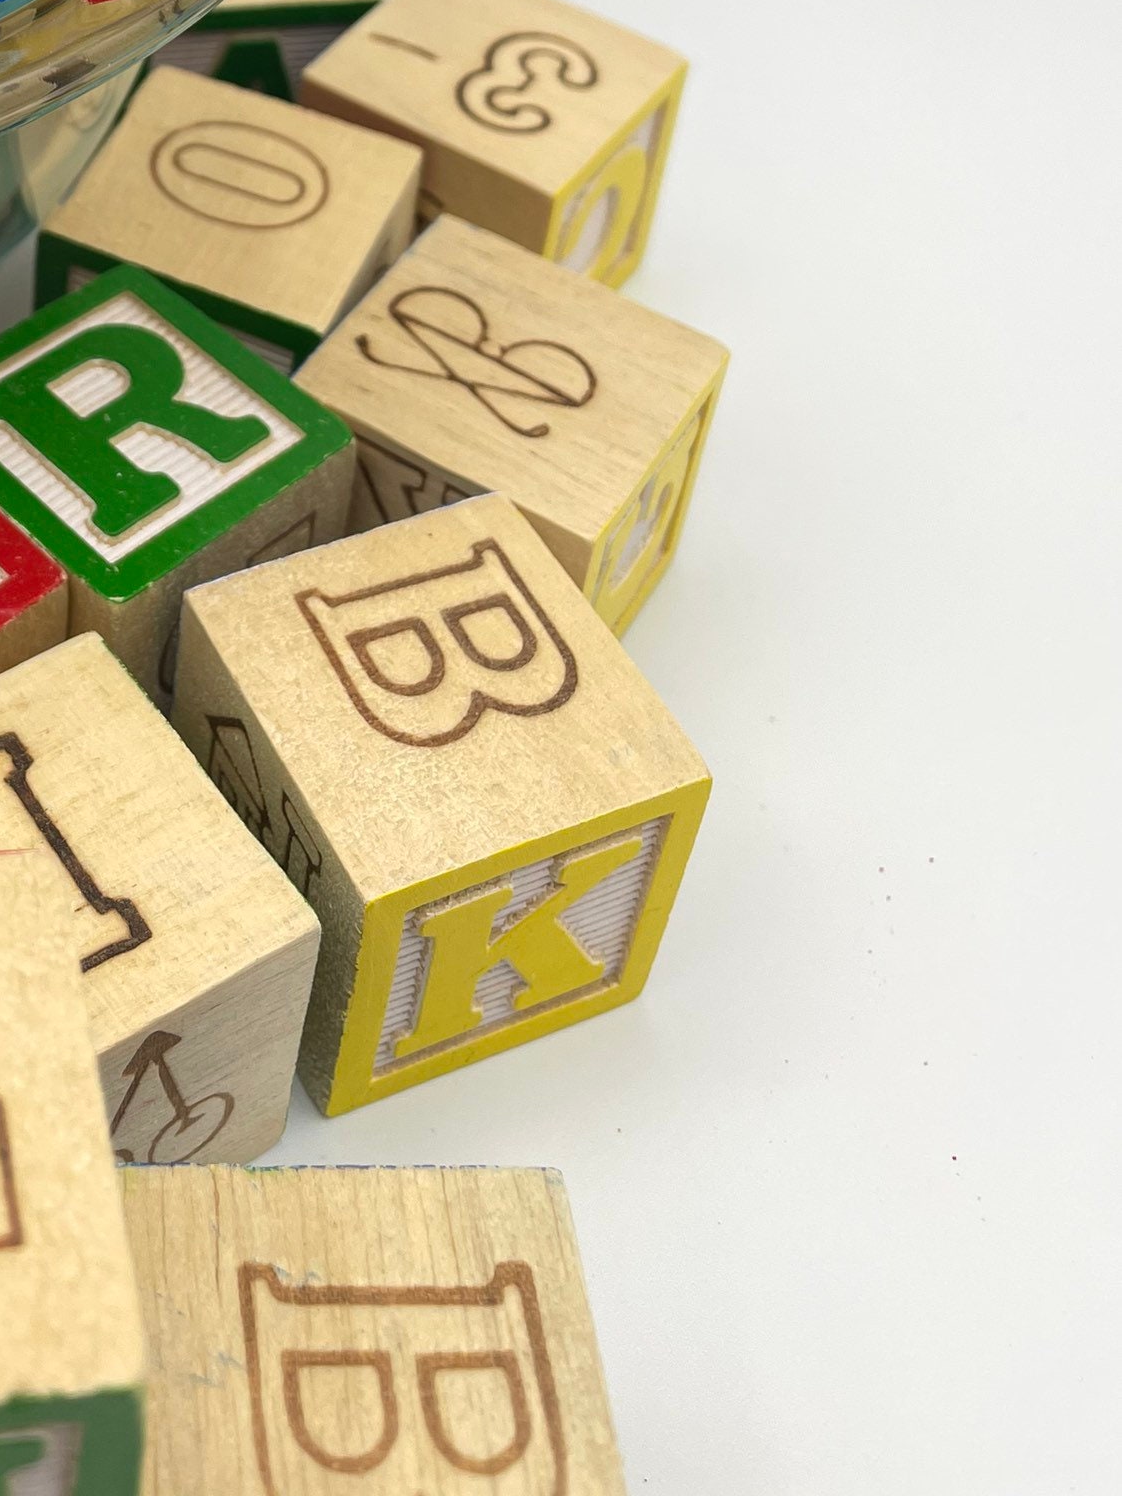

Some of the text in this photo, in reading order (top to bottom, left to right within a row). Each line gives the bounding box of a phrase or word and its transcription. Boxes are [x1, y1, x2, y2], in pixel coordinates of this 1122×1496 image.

[294, 537, 579, 748] B
[395, 829, 646, 1060] K
[237, 1259, 569, 1496] B
